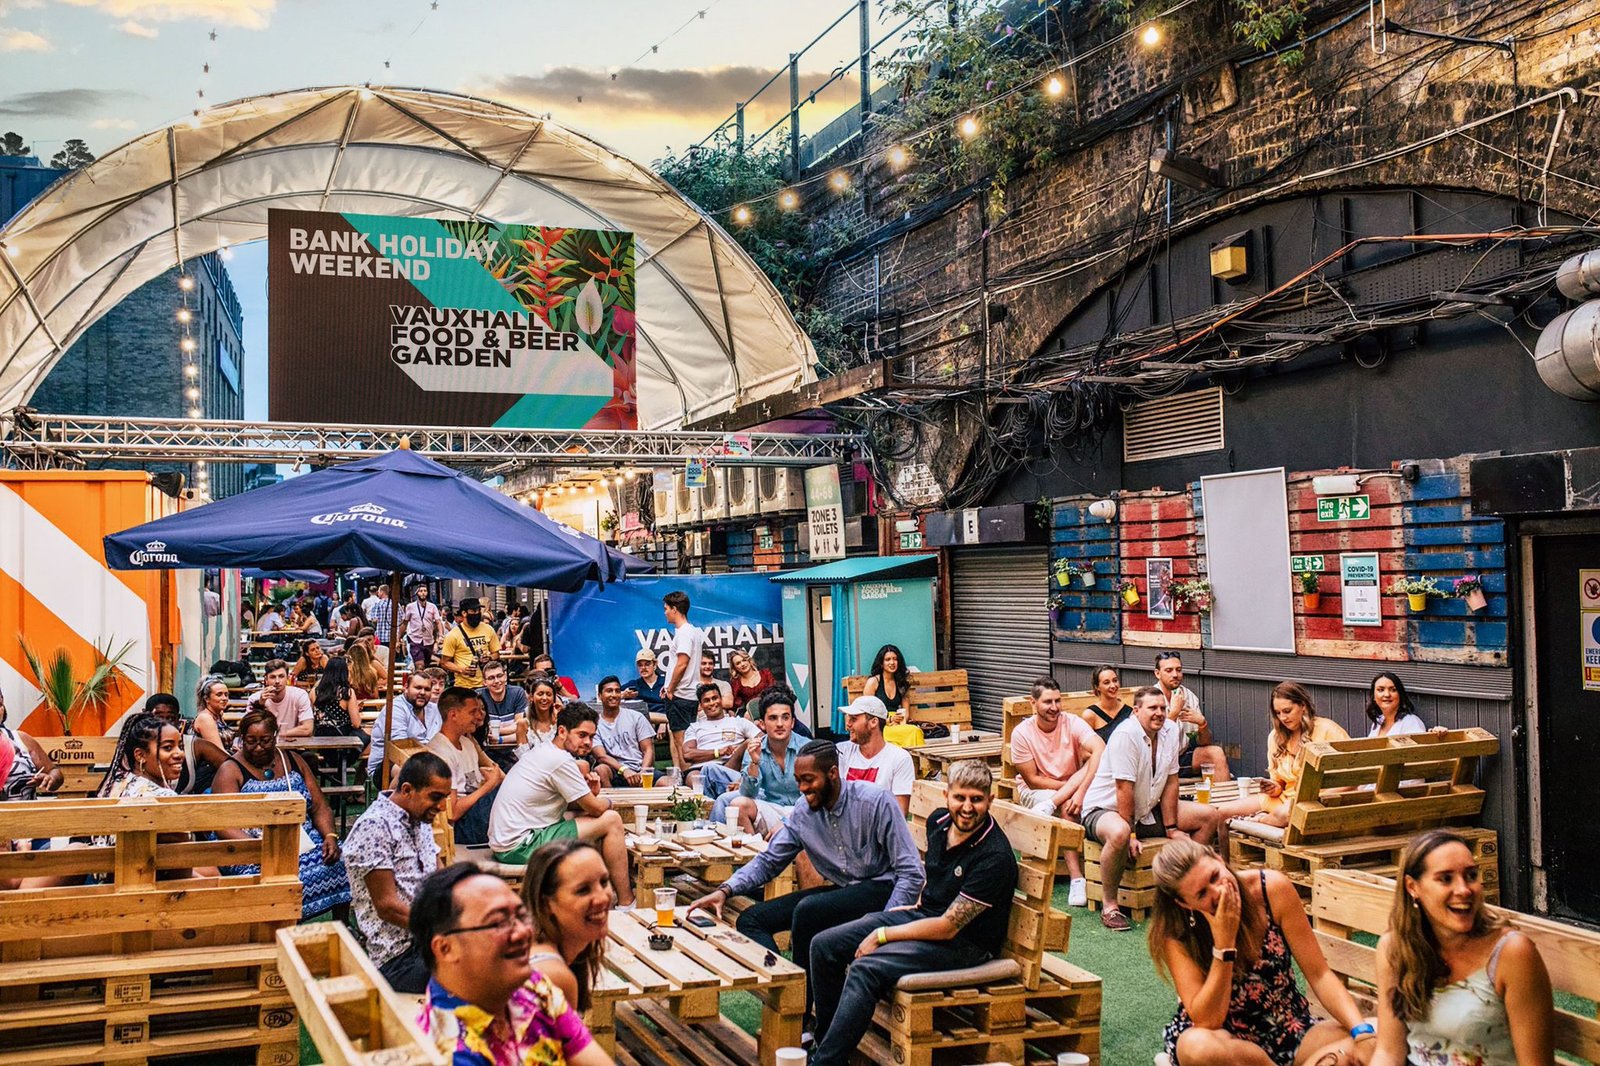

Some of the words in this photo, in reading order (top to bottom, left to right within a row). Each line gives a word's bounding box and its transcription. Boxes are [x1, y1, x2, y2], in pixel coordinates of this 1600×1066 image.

[290, 228, 370, 254] BANK
[379, 234, 499, 260] HOLIDAY
[289, 252, 431, 281] WEEKEND
[390, 305, 544, 331] VAUXHALL
[391, 326, 474, 347] FOOD
[482, 329, 500, 349] &
[508, 330, 580, 352] BEER
[391, 346, 512, 369] GARDEN
[1320, 500, 1334, 510] Fire
[310, 512, 408, 529] Corona
[811, 508, 830, 523] ZONE
[831, 507, 837, 522] 3
[1320, 509, 1334, 519] exit
[812, 522, 839, 536] TOILETS
[129, 550, 180, 567] Corona
[1347, 565, 1374, 573] COVID-19
[635, 622, 784, 650] VAXHALL
[48, 749, 95, 764] Corona
